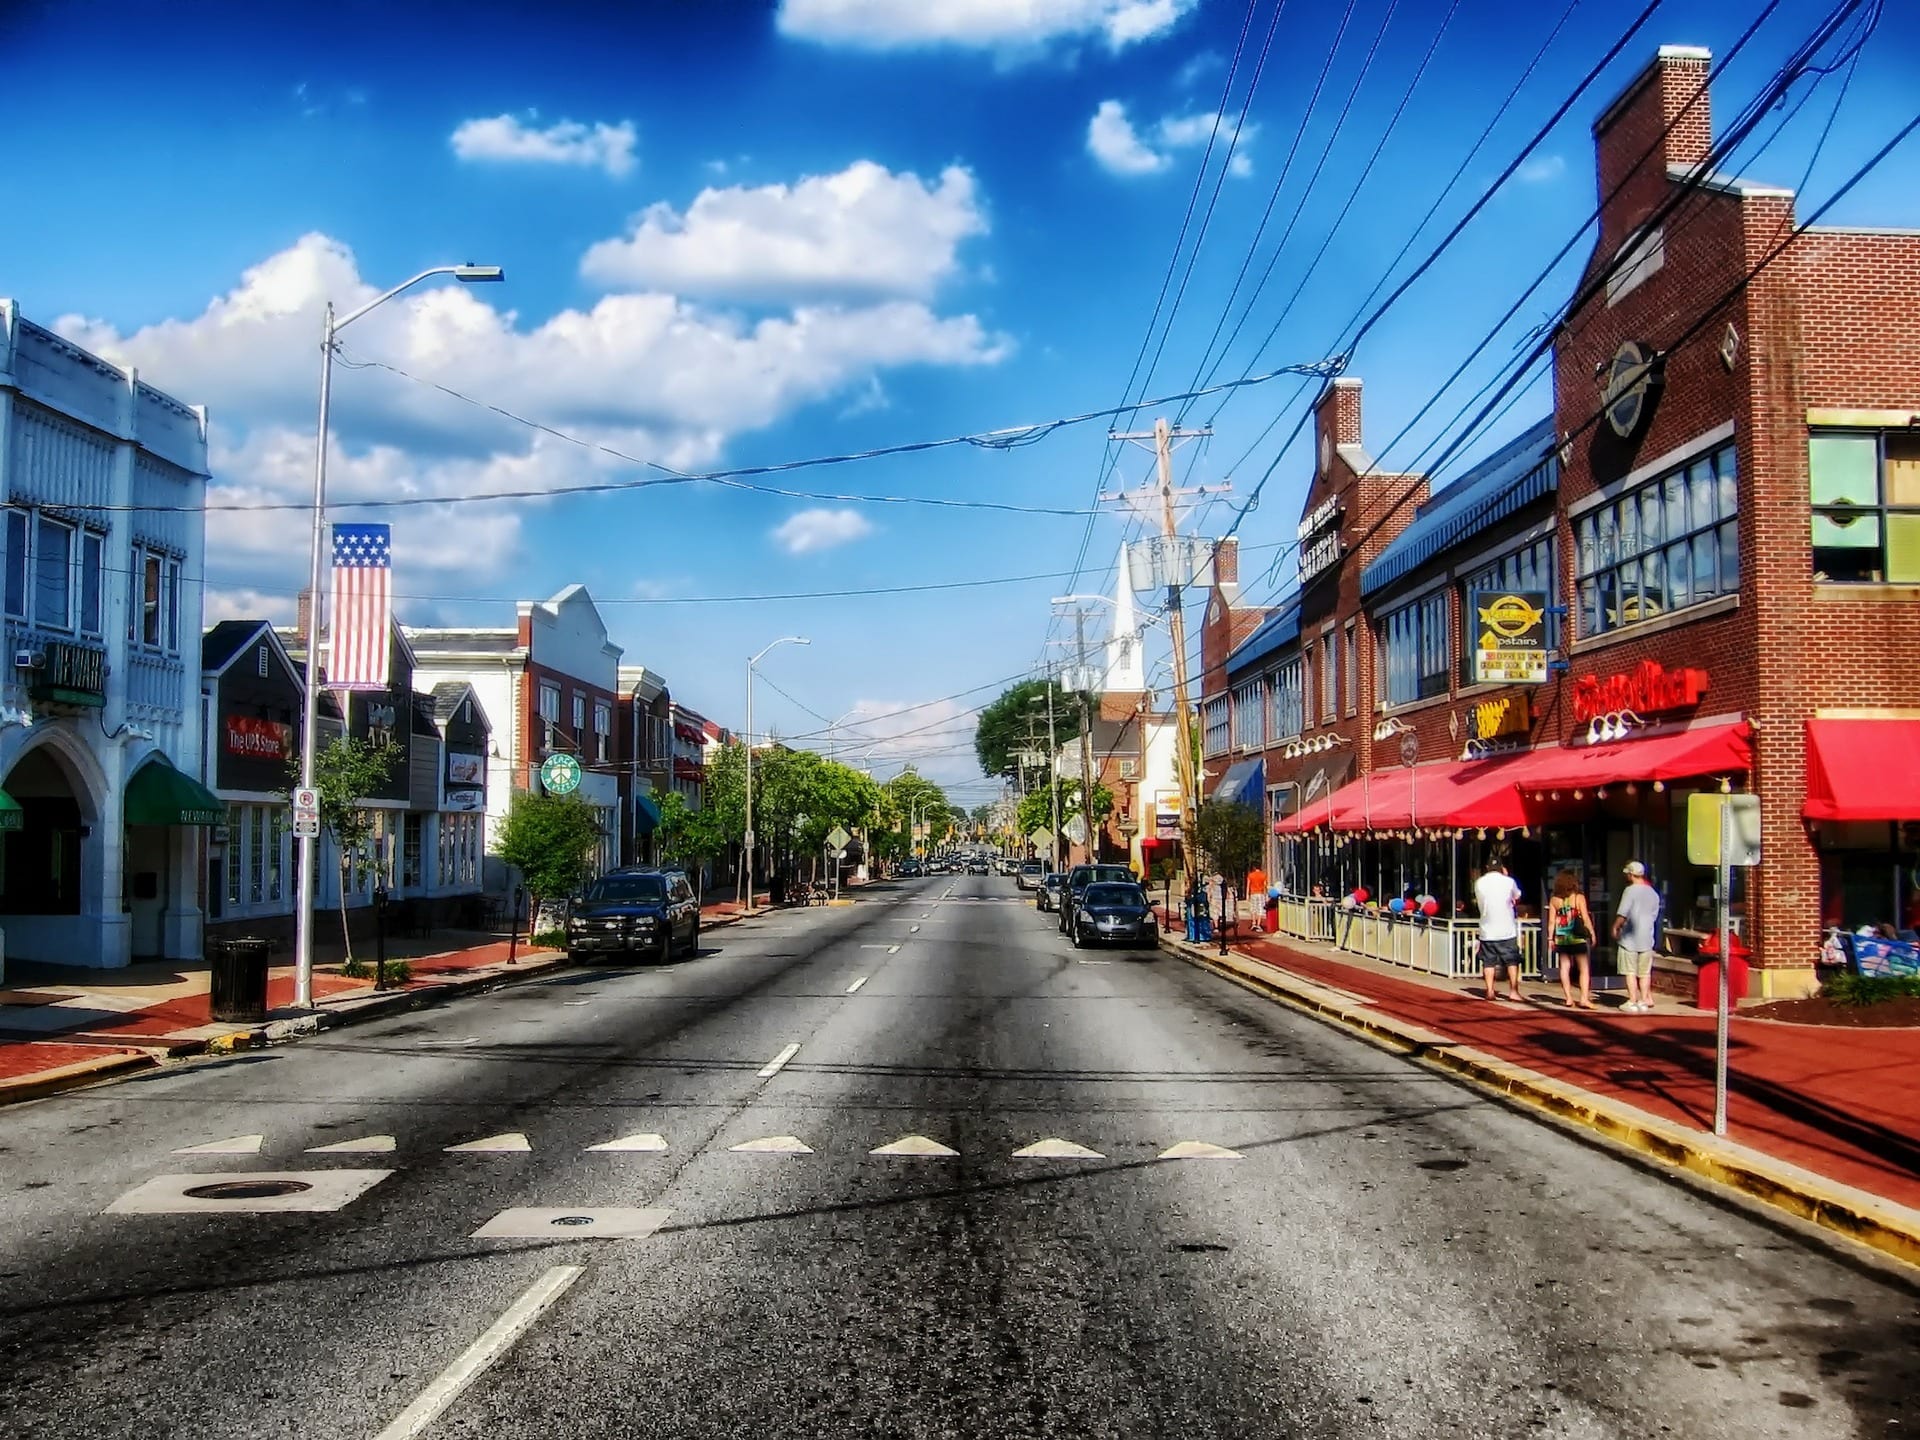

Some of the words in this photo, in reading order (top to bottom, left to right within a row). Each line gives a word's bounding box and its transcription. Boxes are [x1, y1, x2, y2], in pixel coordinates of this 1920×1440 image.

[53, 643, 105, 692] NEWARK
[229, 730, 245, 749] The
[245, 733, 260, 752] UPS
[260, 735, 280, 754] Store
